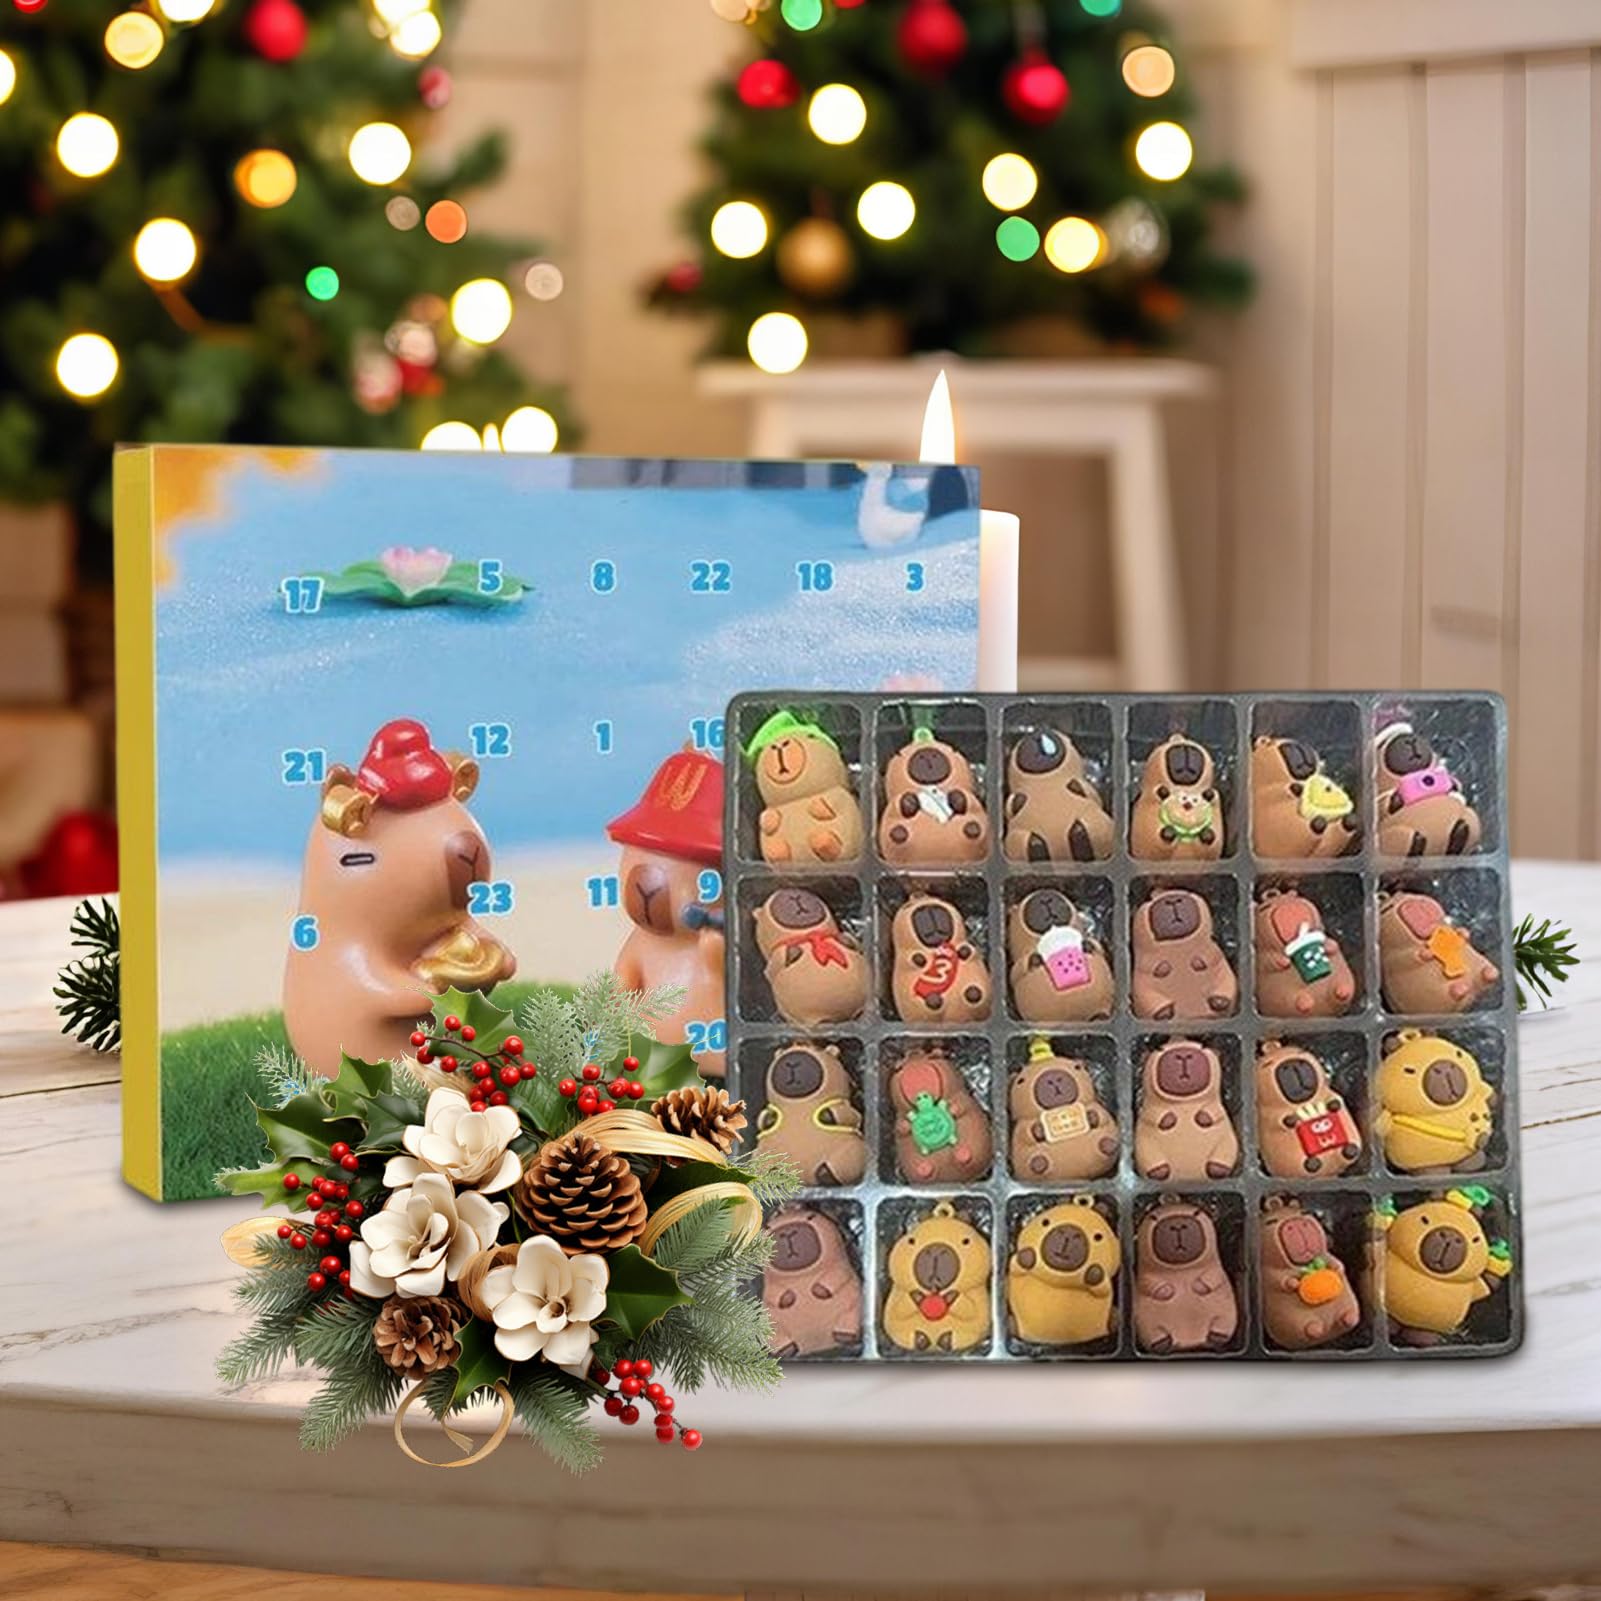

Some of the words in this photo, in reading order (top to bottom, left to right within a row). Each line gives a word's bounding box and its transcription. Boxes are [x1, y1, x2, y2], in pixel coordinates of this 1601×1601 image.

[479, 560, 501, 593] 5
[591, 561, 616, 592] 8
[689, 560, 732, 592] 22
[798, 561, 833, 592] 18
[905, 561, 925, 592] 3
[285, 579, 322, 612] 17
[471, 723, 510, 756] 12
[595, 721, 612, 752] 1
[690, 717, 725, 749] 16
[283, 749, 324, 784] 21
[469, 881, 514, 915] 23
[587, 876, 619, 908] 11
[699, 871, 720, 901] 9
[292, 916, 318, 950] 6
[686, 1020, 727, 1053] 20
